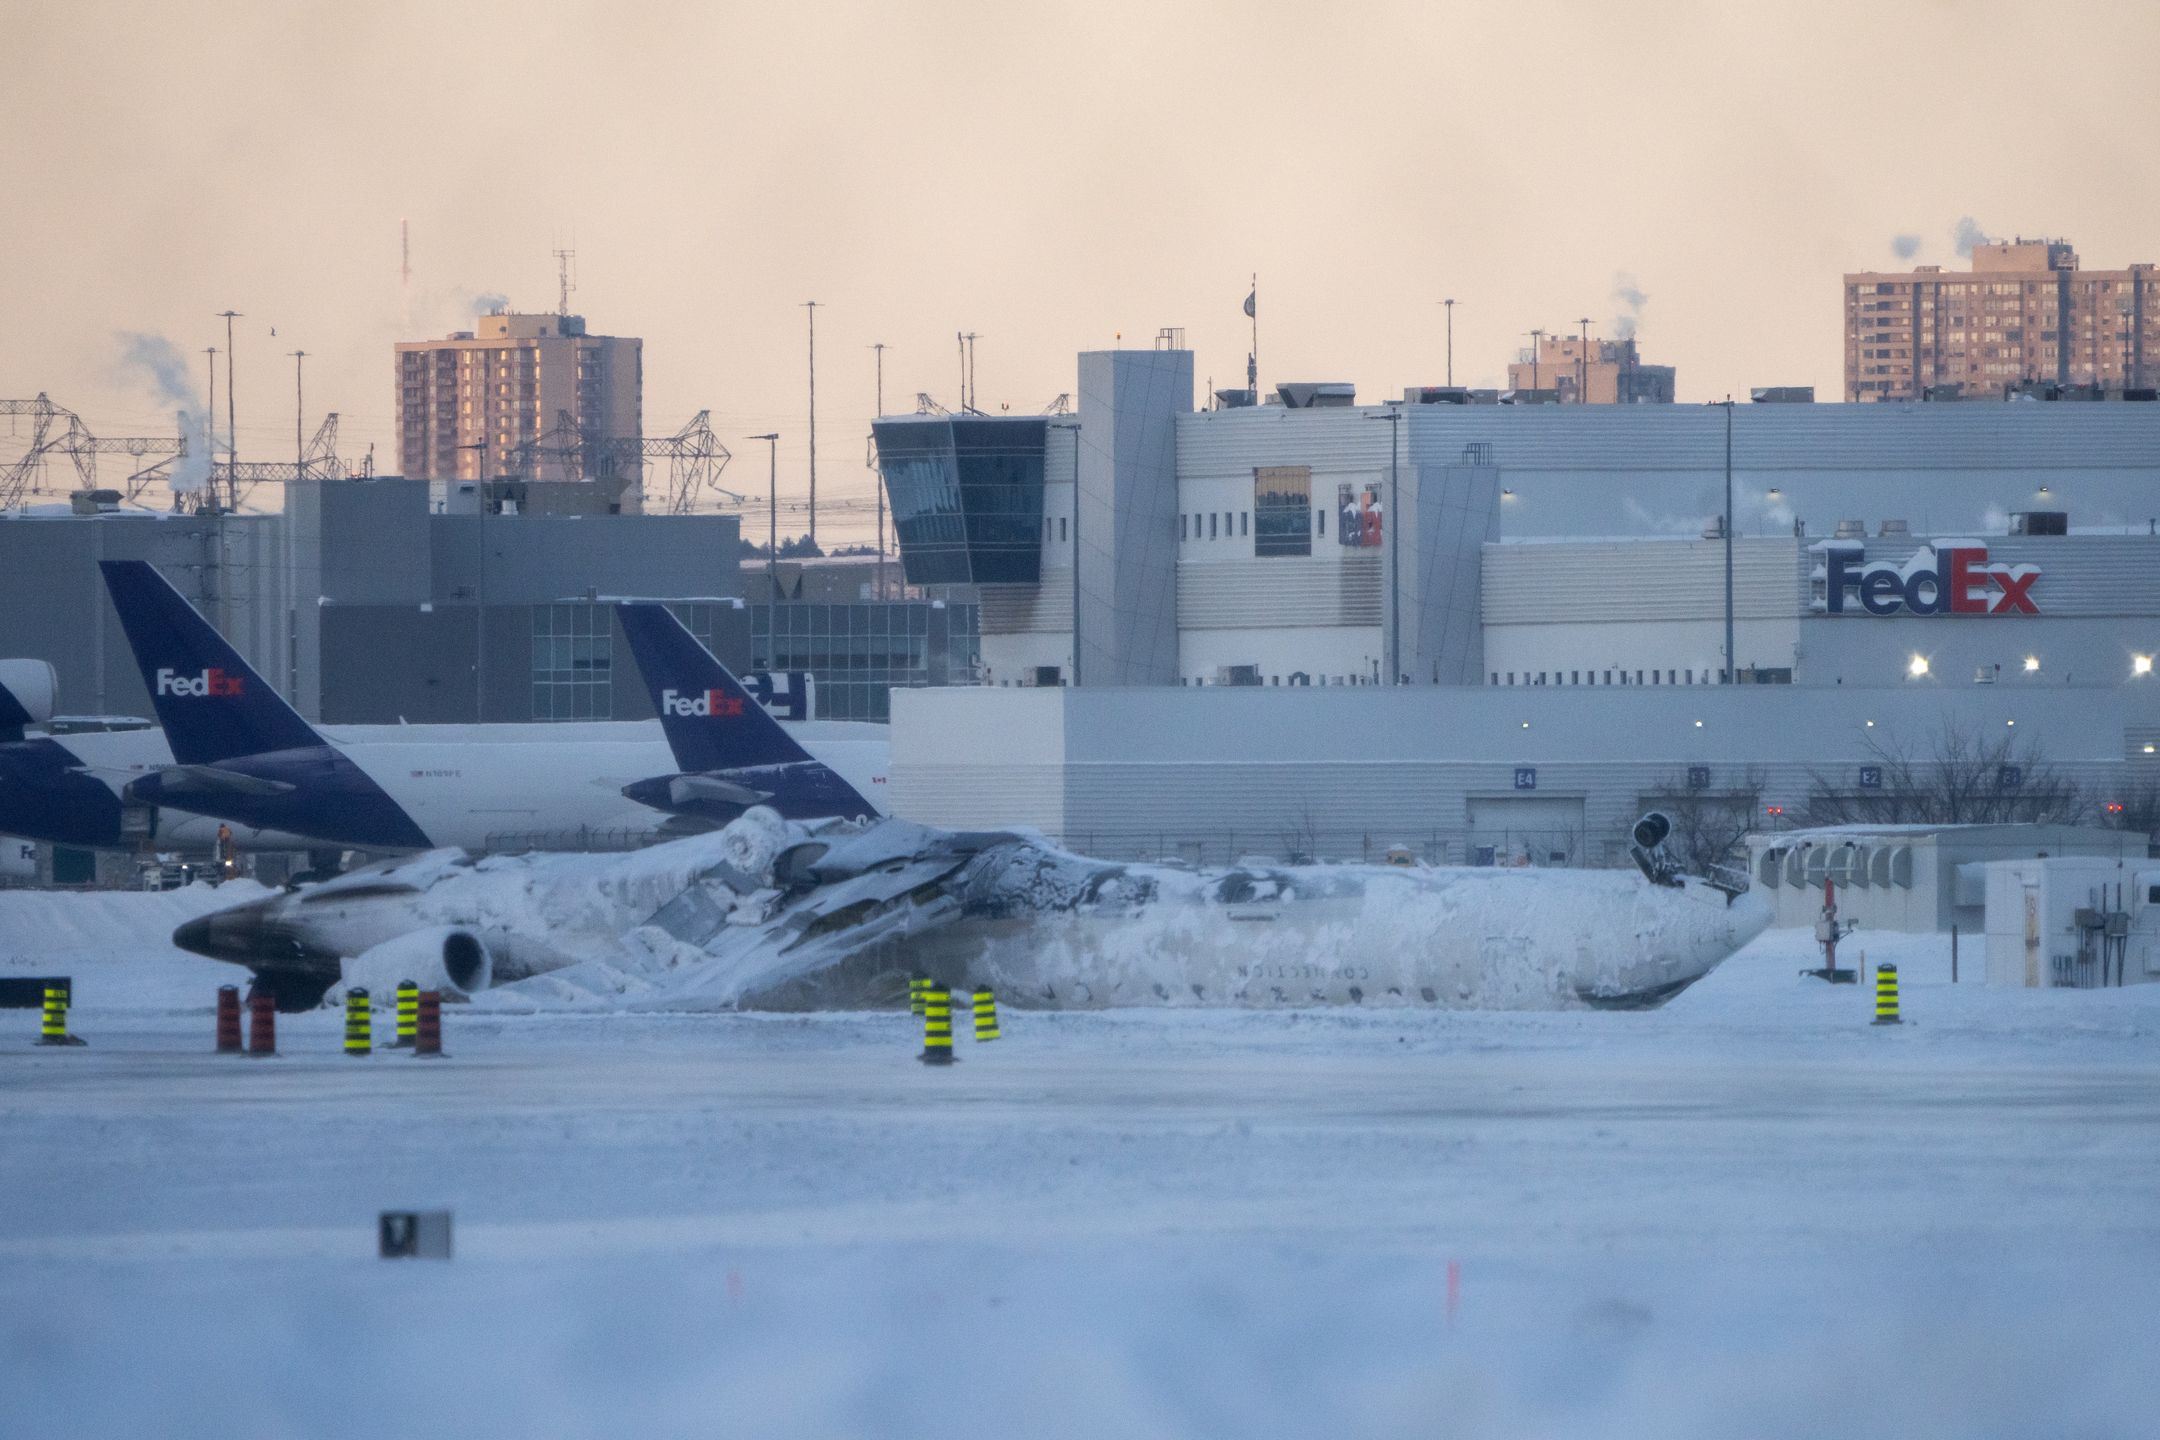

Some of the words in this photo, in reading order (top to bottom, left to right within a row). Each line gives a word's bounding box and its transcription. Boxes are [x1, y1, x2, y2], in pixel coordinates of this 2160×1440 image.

[1827, 547, 2042, 616] FedEx
[157, 668, 245, 696] FedEx
[662, 689, 744, 716] FedEx
[1518, 773, 1533, 786] E4
[1863, 771, 1879, 784] E2
